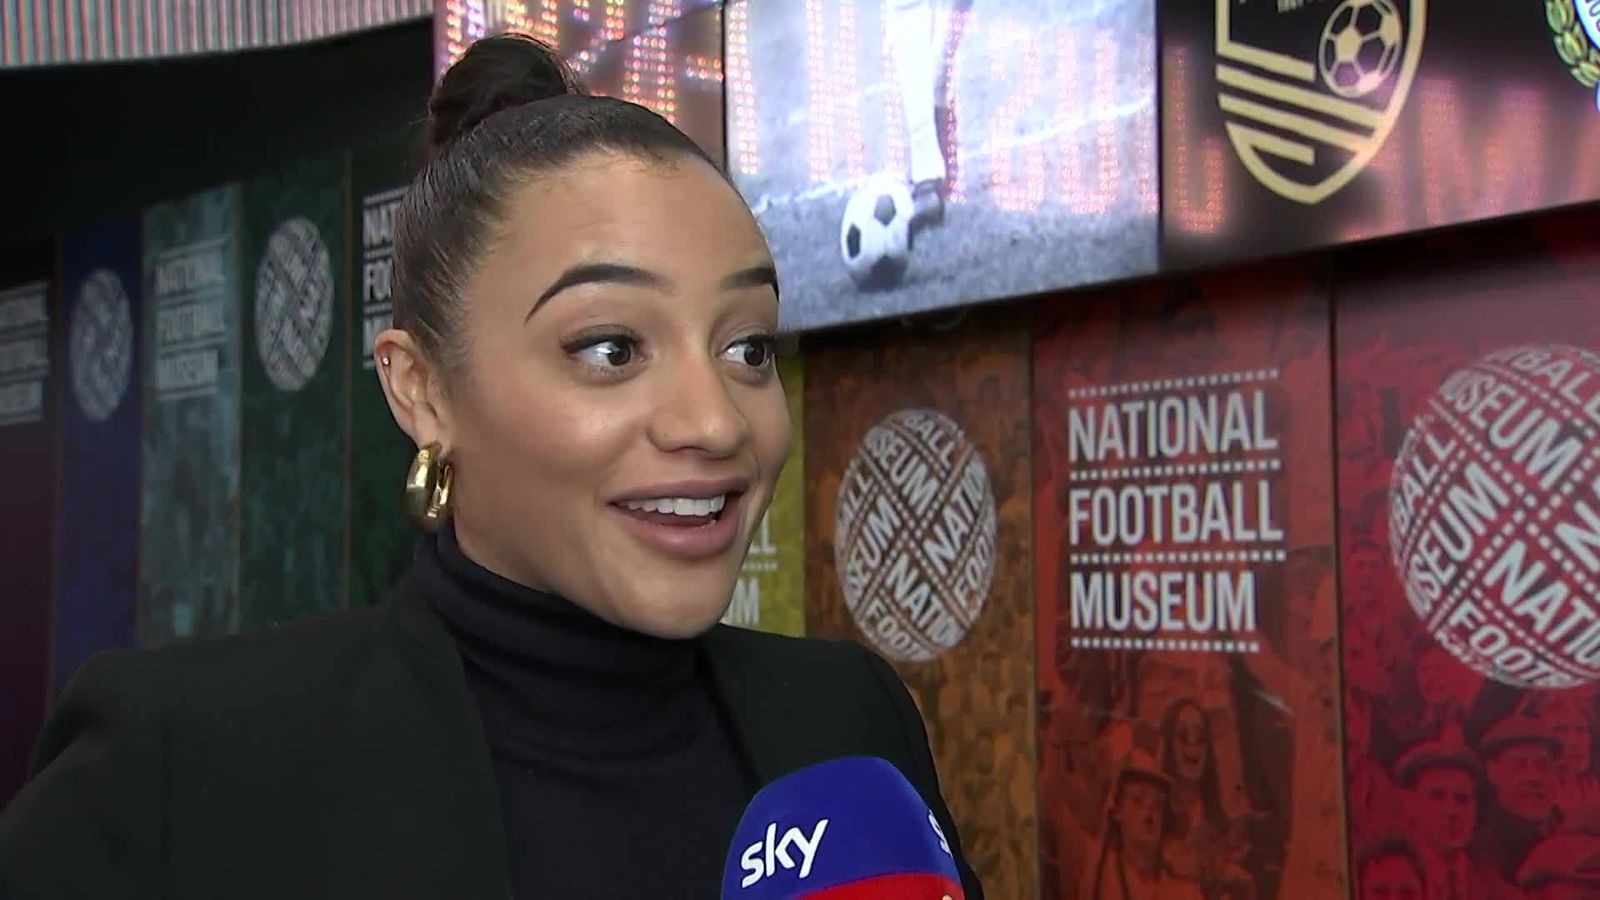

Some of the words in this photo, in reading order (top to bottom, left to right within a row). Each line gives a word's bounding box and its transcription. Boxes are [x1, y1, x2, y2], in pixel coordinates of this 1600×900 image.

[1068, 390, 1278, 463] NATIONAL
[1069, 480, 1284, 546] FOOTBALL
[1070, 570, 1256, 632] MUSEUM
[741, 819, 829, 888] sky
